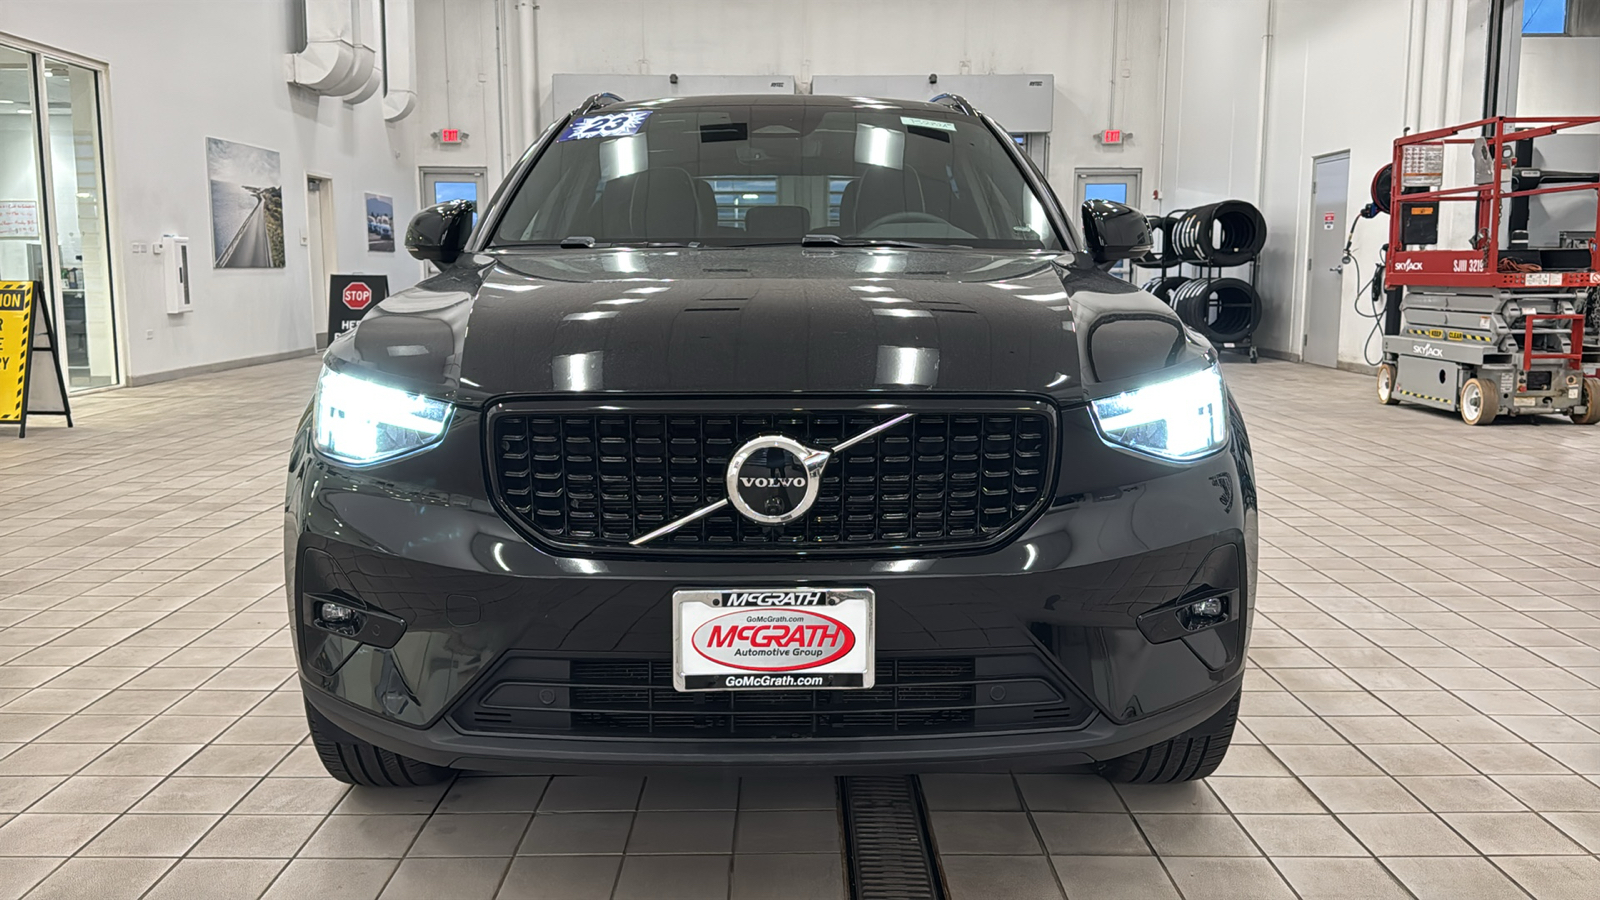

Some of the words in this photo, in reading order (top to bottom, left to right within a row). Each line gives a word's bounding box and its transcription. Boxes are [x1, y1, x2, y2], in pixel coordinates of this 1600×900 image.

[583, 117, 629, 133] 23
[1395, 259, 1423, 272] SKYJACK
[345, 290, 370, 301] STOP
[1413, 343, 1443, 357] SKYJACK
[740, 477, 806, 488] VOLVO
[746, 615, 804, 623] GoMcGrath.com
[734, 647, 790, 657] Automotive
[792, 647, 823, 658] Group
[725, 675, 823, 687] GoMcGrath.com
